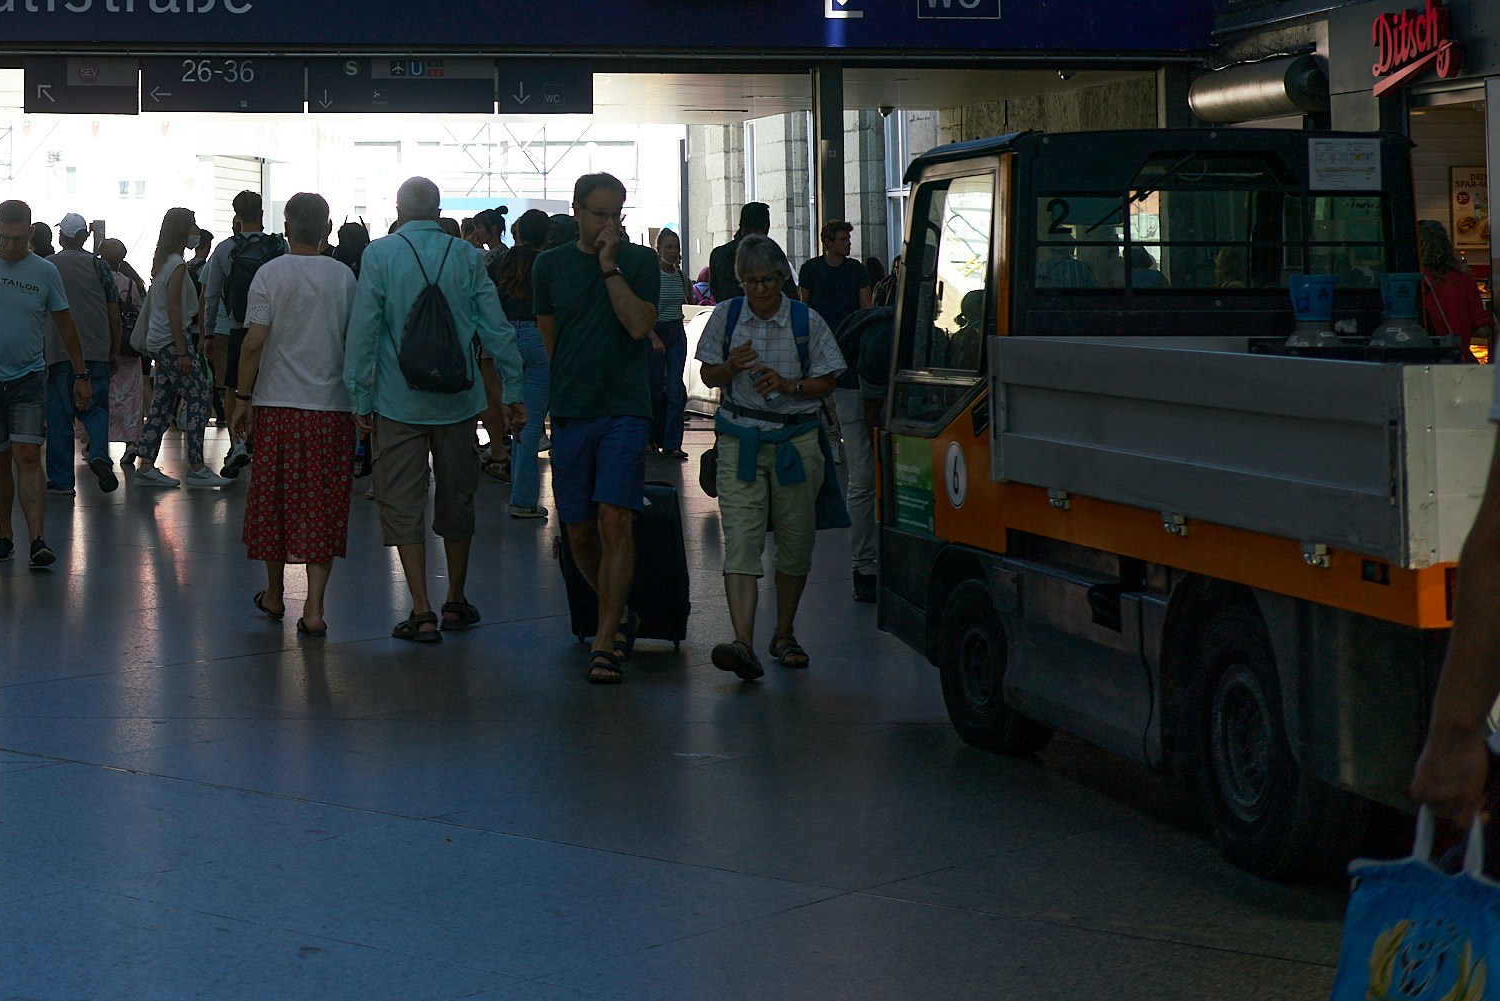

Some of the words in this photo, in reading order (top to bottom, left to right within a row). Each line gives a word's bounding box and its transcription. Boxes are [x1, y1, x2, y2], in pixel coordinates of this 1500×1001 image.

[80, 68, 98, 78] SEV
[181, 60, 255, 83] 26-36
[545, 94, 560, 103] WC
[1047, 198, 1072, 234] 2
[1, 277, 40, 292] TAILOR
[953, 455, 960, 494] 6
